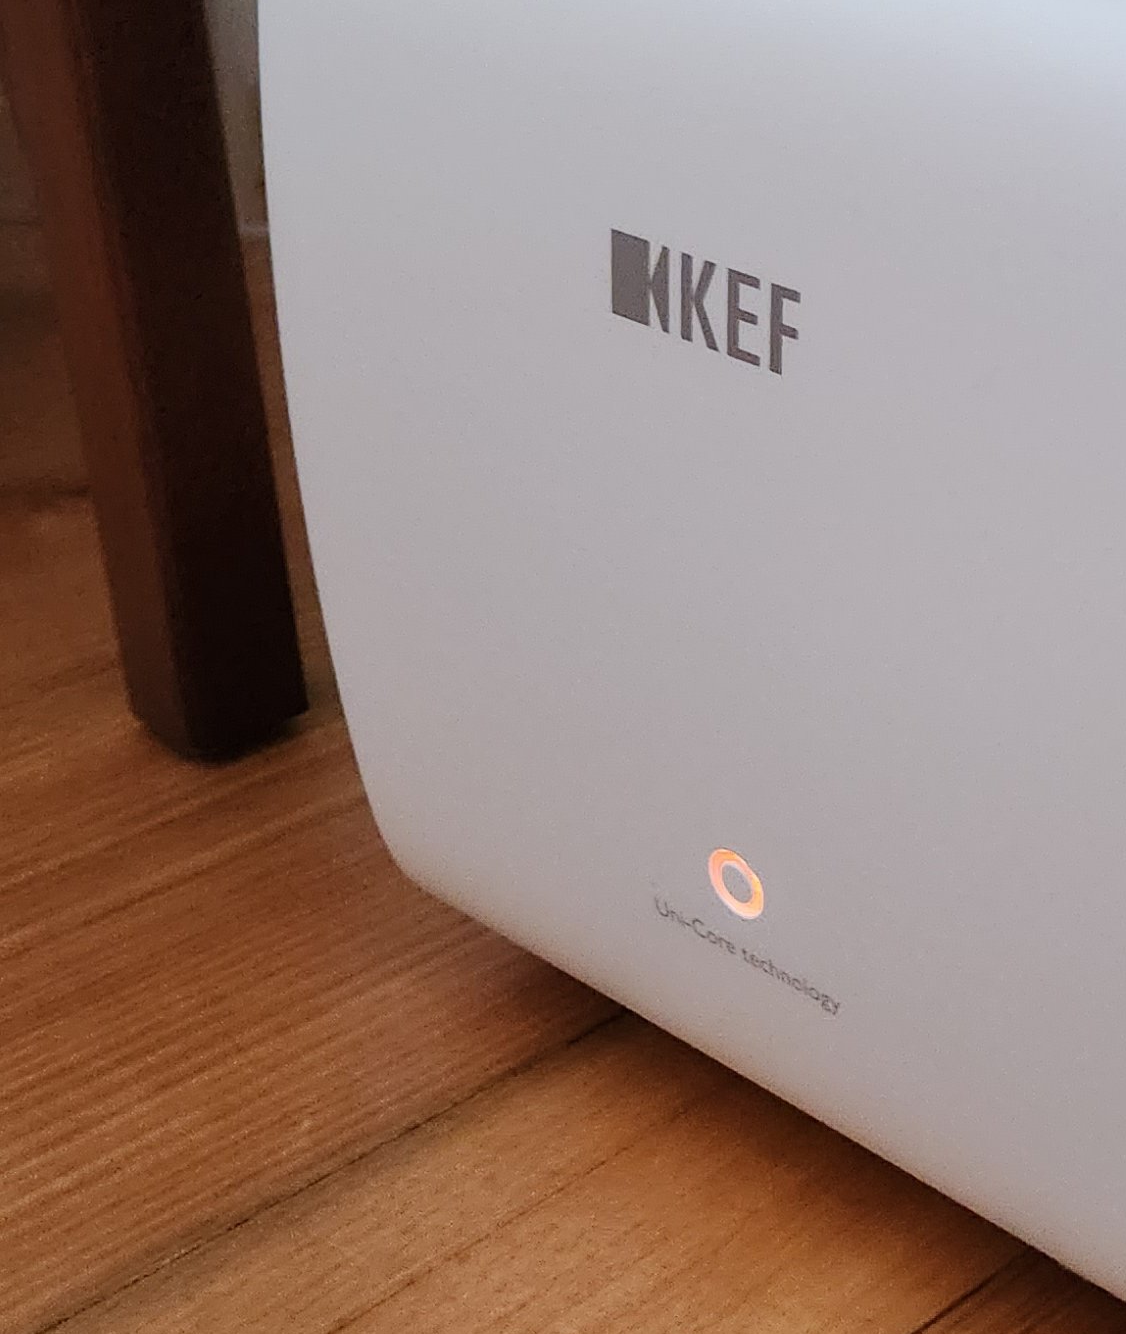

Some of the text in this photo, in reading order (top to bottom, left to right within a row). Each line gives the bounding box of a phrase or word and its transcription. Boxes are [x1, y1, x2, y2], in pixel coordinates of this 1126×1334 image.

[680, 251, 801, 376] KEF
[654, 895, 841, 1016] Uni-Core technology
